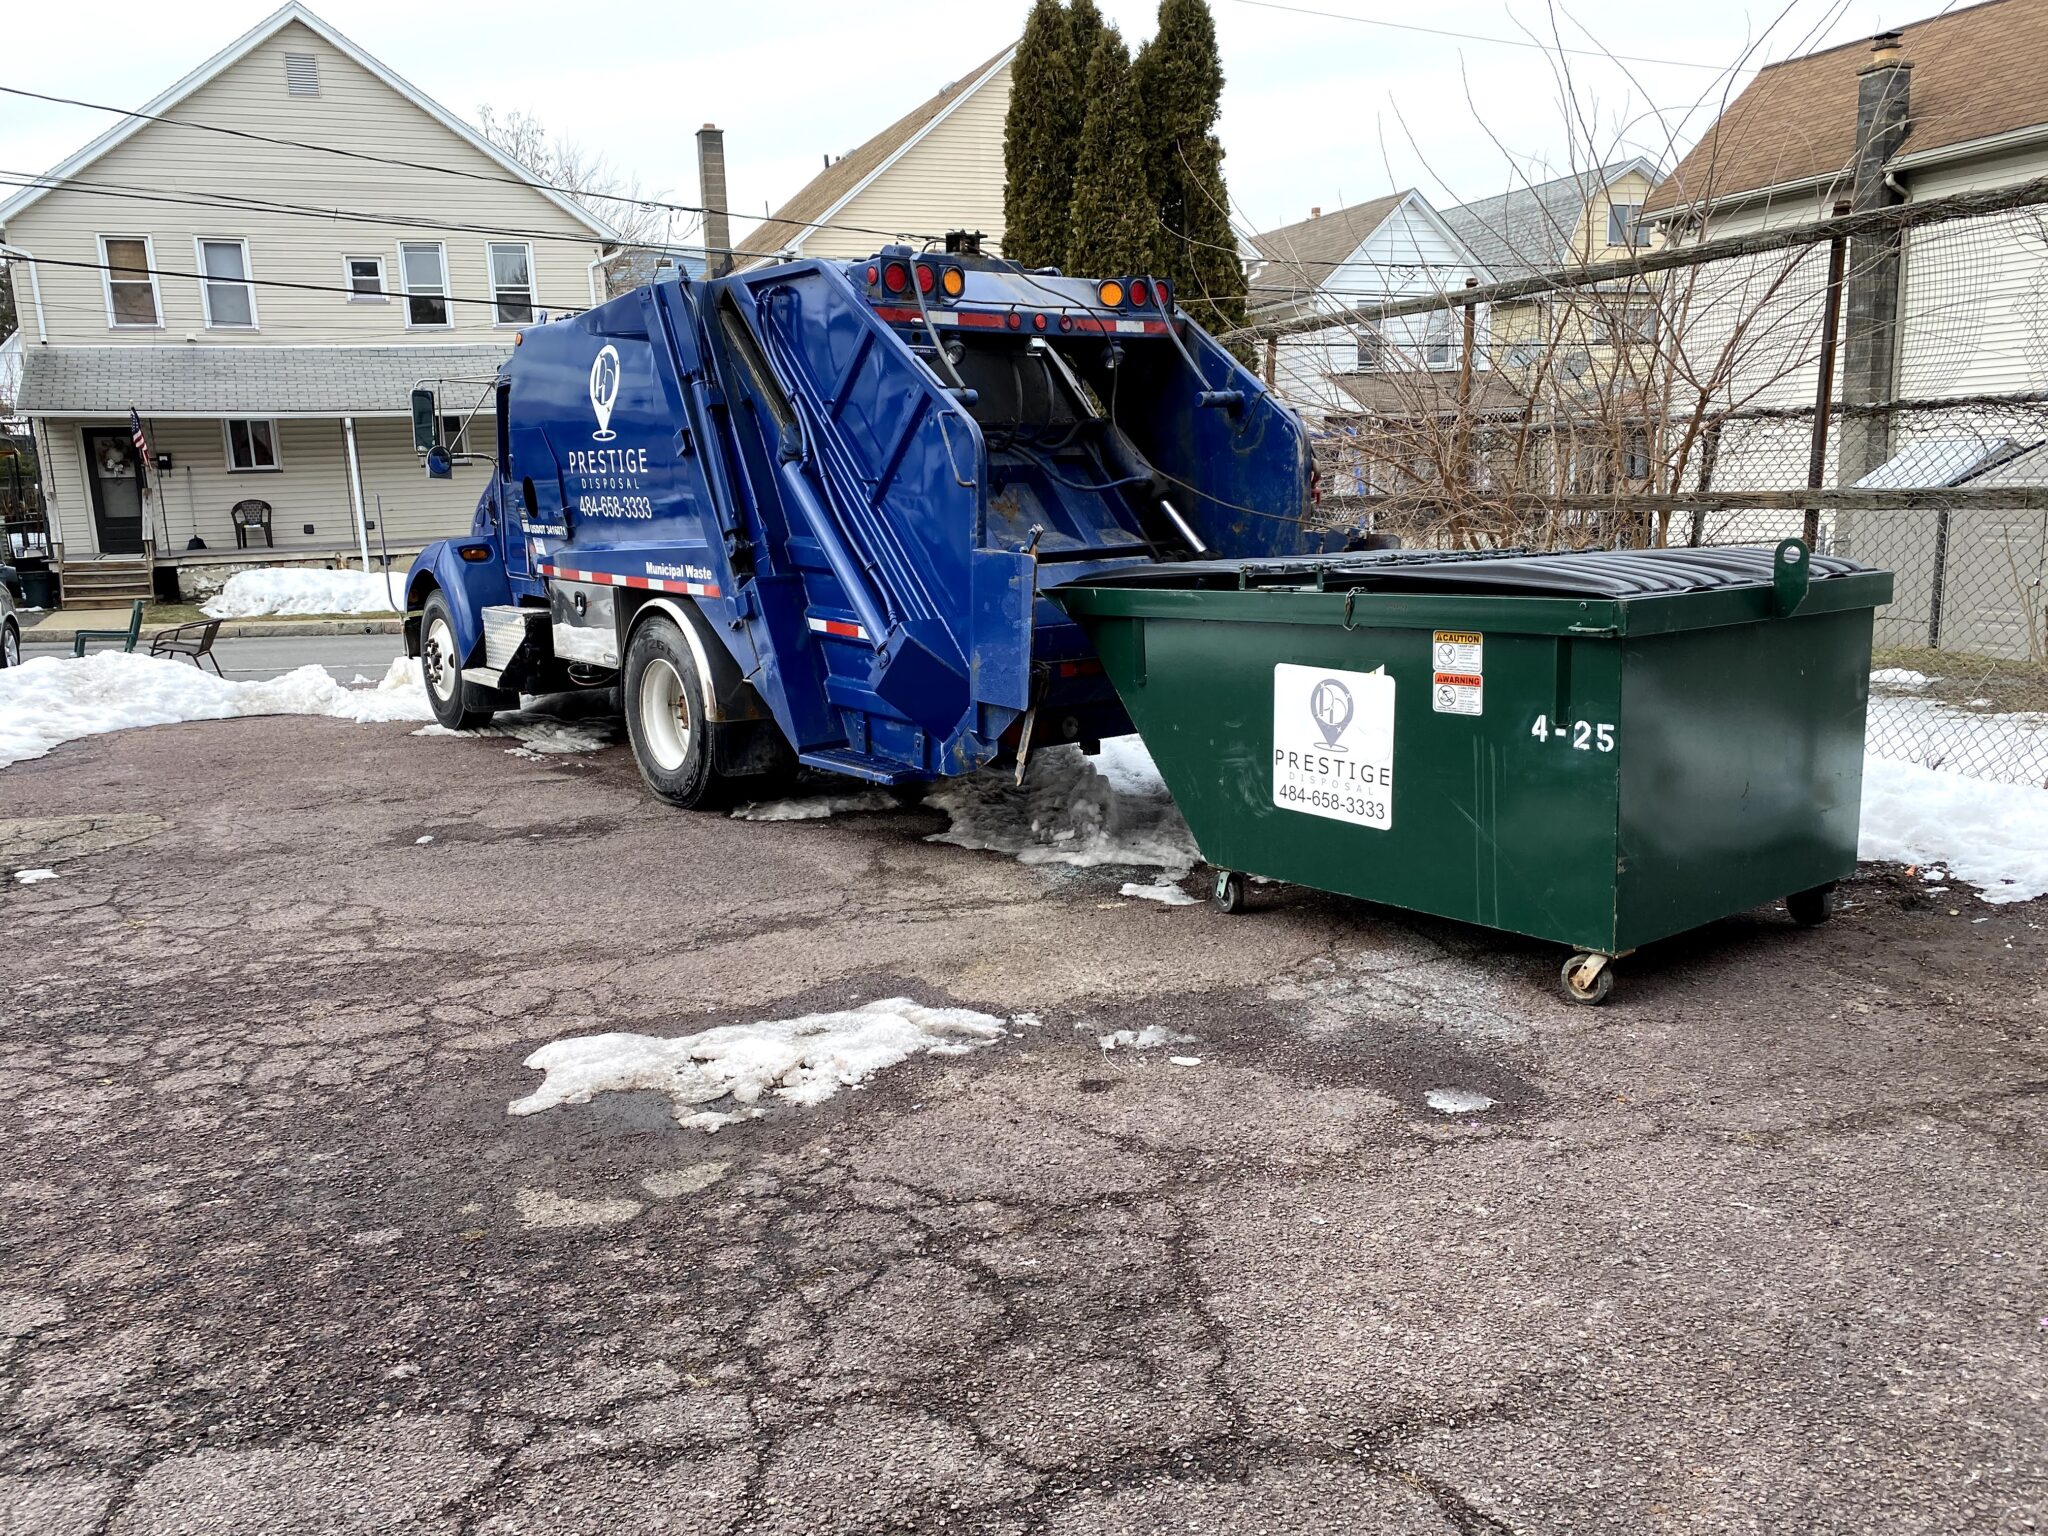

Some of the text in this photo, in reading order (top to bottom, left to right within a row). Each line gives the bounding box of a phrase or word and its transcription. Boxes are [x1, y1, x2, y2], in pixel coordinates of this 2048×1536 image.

[569, 448, 648, 474] PRESTIGE
[581, 478, 640, 490] DISPOSAL
[580, 495, 652, 520] 484-658-3333
[530, 524, 546, 535] USDOT
[646, 561, 712, 580] Municipal Waste
[1443, 634, 1480, 643] CAUTION
[1443, 676, 1480, 685] WARNING
[1531, 714, 1615, 752] 4-25
[1275, 749, 1391, 786] PRESTIGE
[1289, 771, 1374, 796] DISPOSAL
[1279, 784, 1386, 820] 484-658-3333
